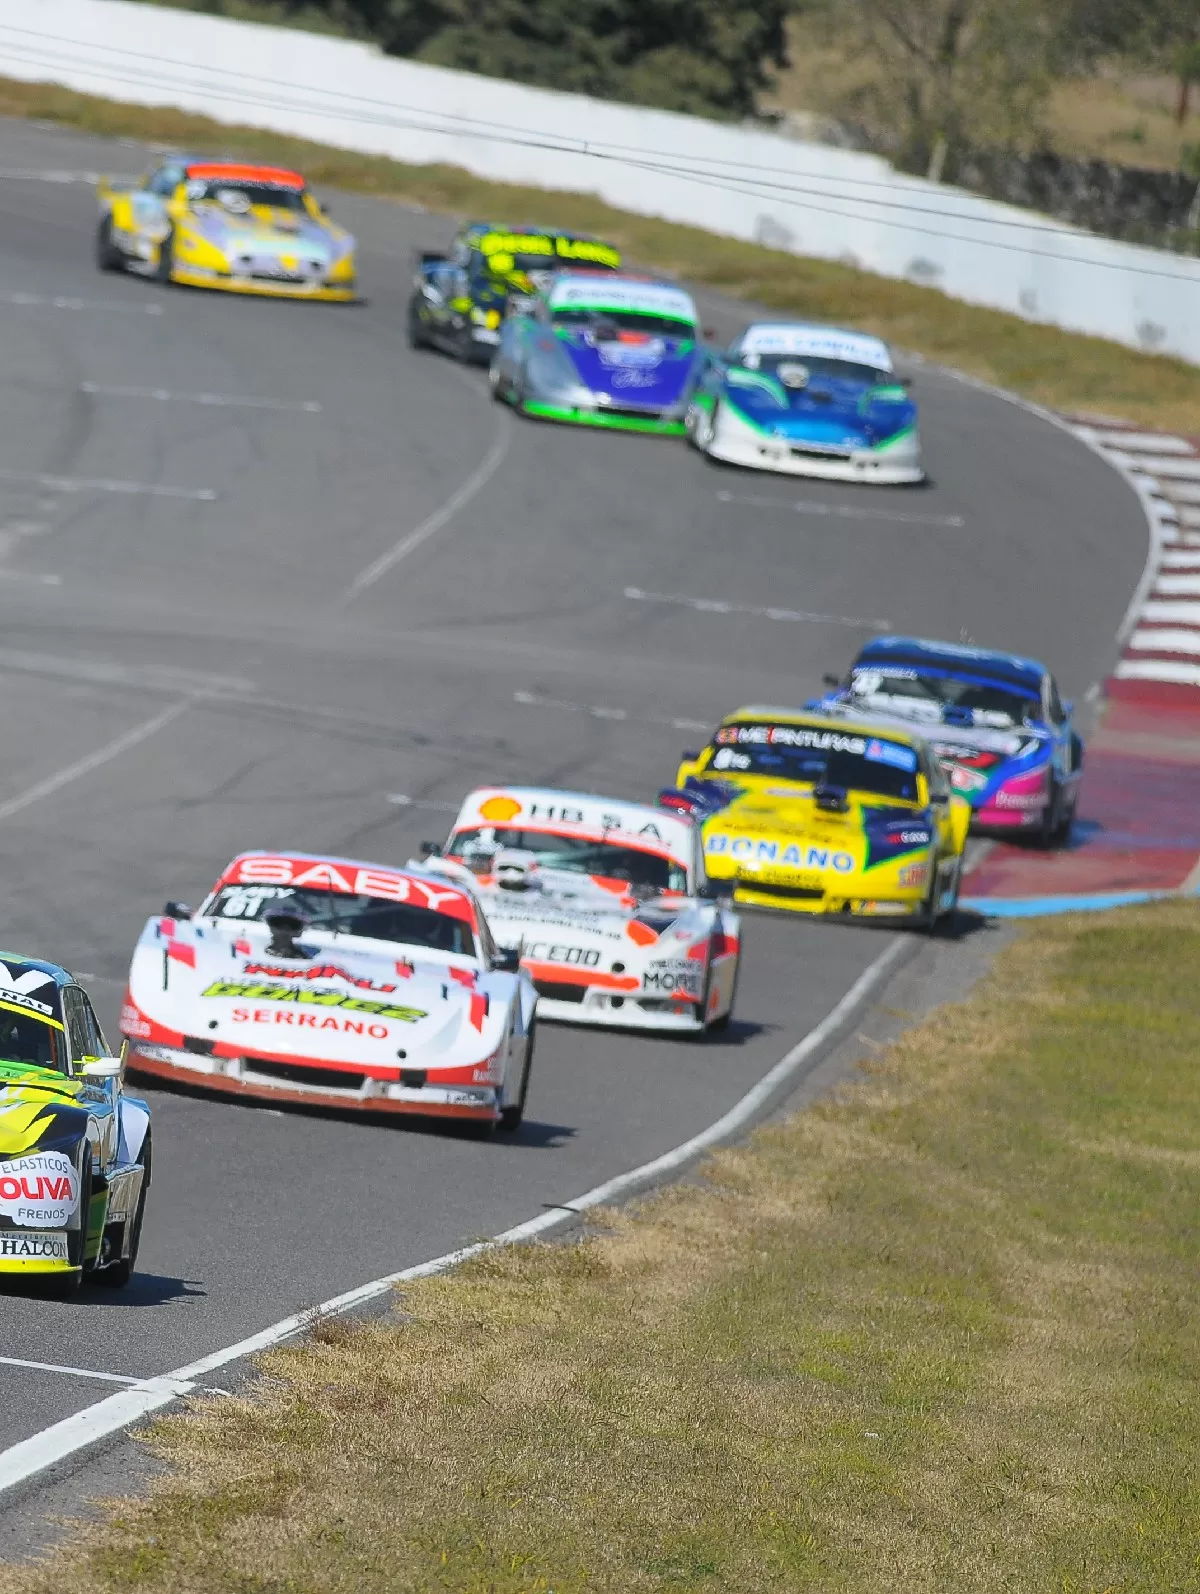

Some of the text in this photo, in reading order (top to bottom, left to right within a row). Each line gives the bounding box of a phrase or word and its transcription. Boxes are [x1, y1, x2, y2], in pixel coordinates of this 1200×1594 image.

[704, 833, 856, 873] BONANO
[238, 858, 459, 911] SABY
[231, 1006, 390, 1041] SERRANO
[1, 1157, 69, 1174] ELASTICOS
[17, 1207, 66, 1220] FRENOS
[0, 1240, 67, 1258] HALCON
